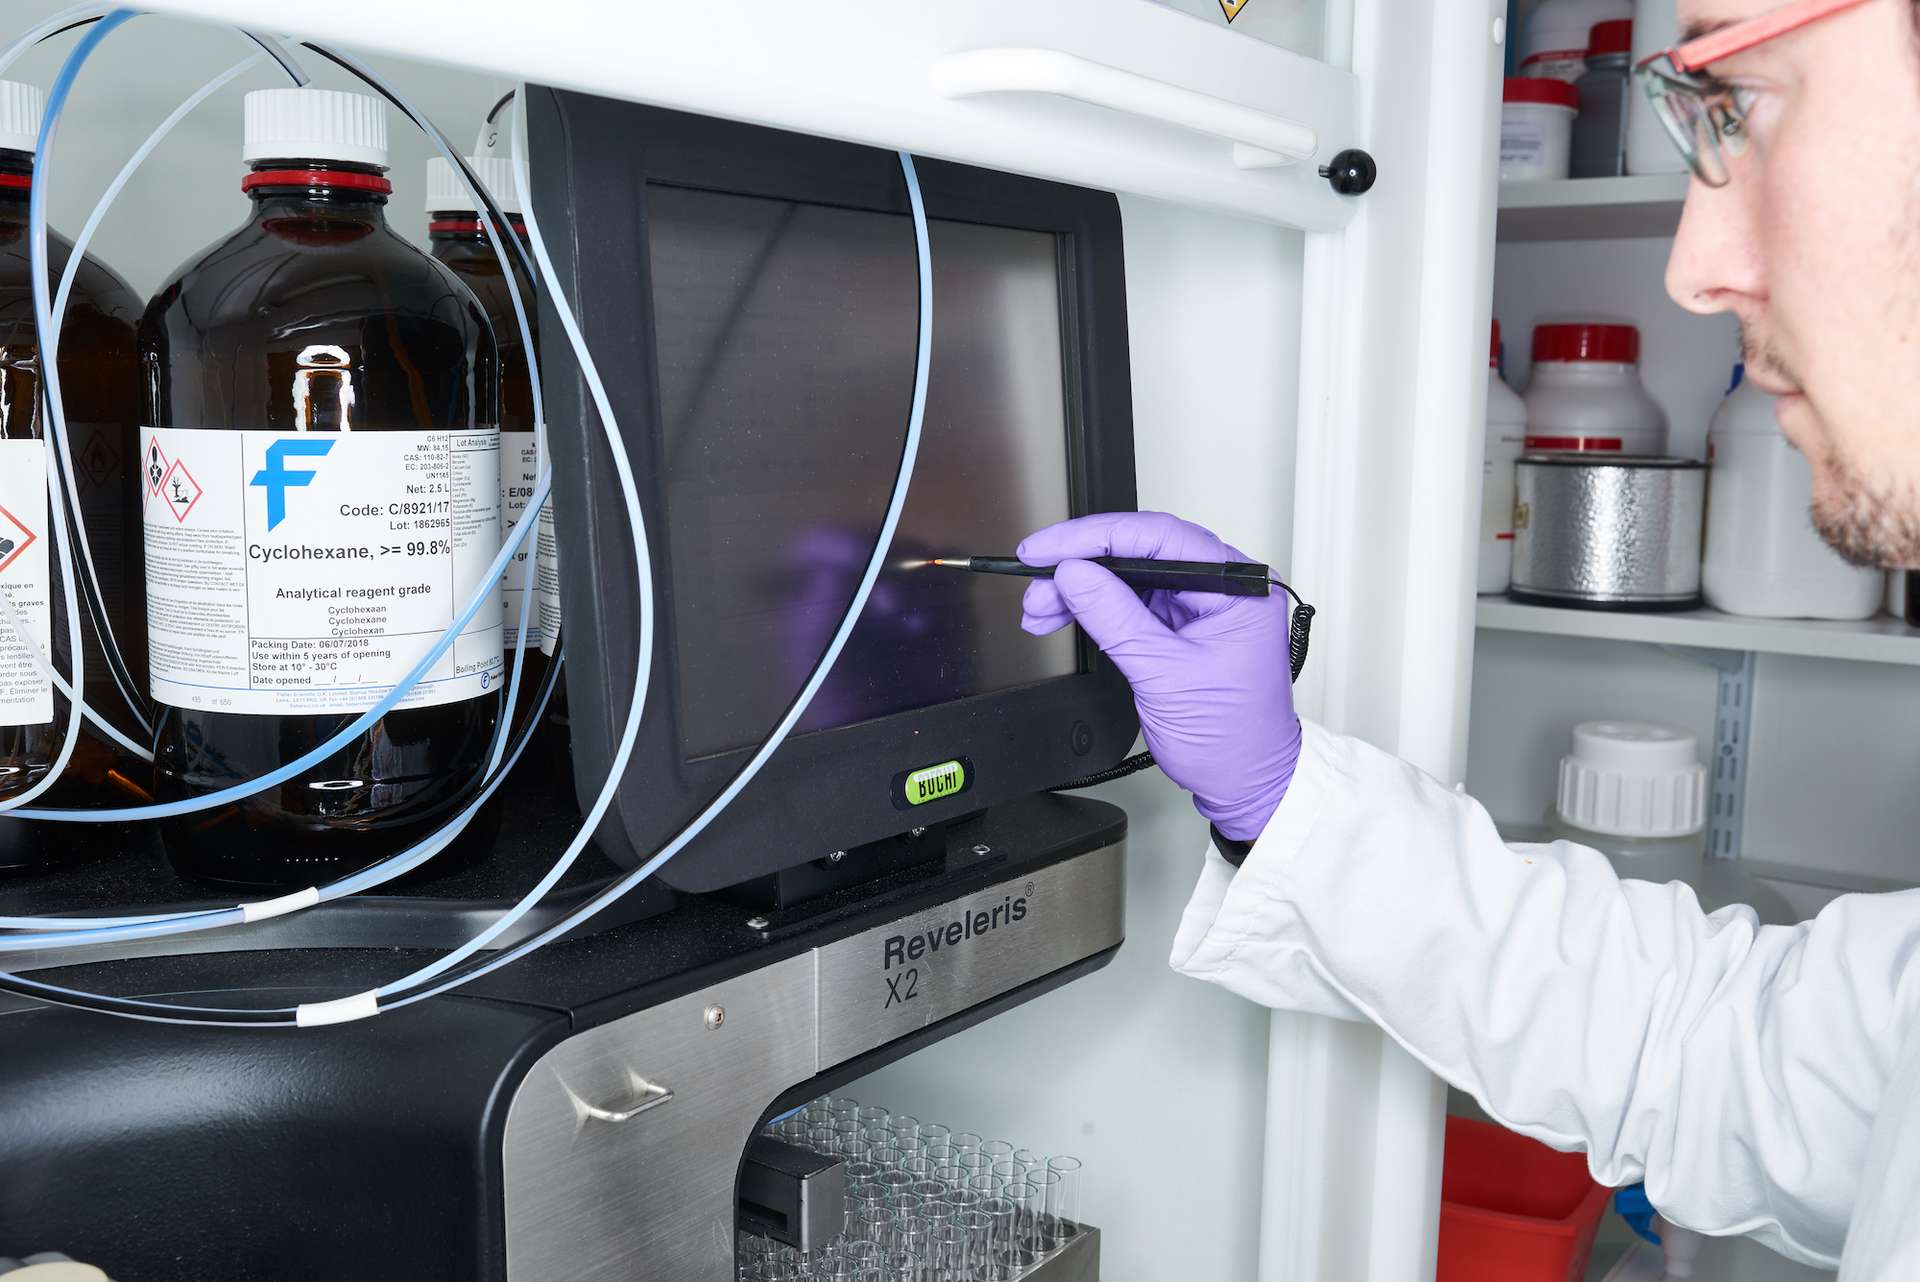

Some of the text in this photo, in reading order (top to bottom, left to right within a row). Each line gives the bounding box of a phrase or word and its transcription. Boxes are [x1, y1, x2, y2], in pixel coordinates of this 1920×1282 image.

[406, 483, 450, 494] Net: 2.5 L
[340, 502, 450, 516] Code: C/8921/17
[390, 520, 450, 530] Lot: 1862965
[248, 544, 374, 563] Cyclohexane,
[406, 539, 450, 556] 99.8%
[276, 583, 432, 601] Analytical reagent grade
[328, 605, 387, 614] Cyclohexaan
[328, 616, 387, 626] Cyclohexane
[331, 626, 384, 638] Cyclohexan
[251, 638, 369, 650] Packing Date: 06/07/2018
[252, 648, 391, 662] Use within 5 years of opening
[252, 663, 277, 672] Store
[279, 663, 288, 672] at
[291, 662, 306, 672] 10°
[314, 662, 338, 672] 30°C
[252, 676, 312, 687] Date opened
[884, 968, 919, 1009] X2
